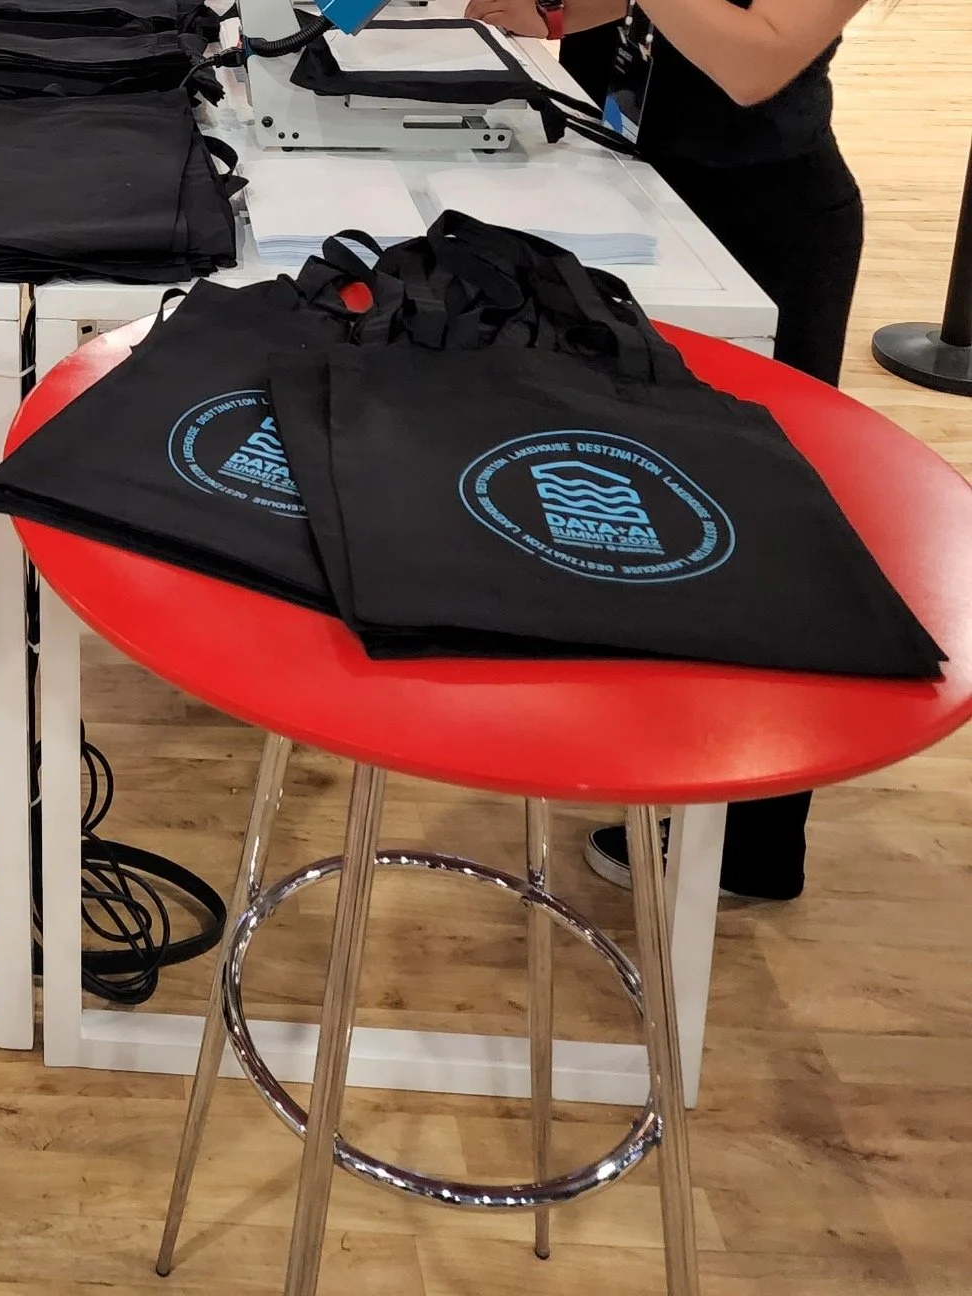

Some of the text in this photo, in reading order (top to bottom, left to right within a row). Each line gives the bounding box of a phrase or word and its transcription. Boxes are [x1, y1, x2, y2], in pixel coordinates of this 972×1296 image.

[196, 397, 257, 426] DESTINATION
[508, 442, 571, 460] LAKEHOUSE
[577, 442, 663, 476] DESTINATION
[223, 461, 280, 483] SUMMIT
[229, 452, 290, 478] DATA
[545, 512, 657, 539] DATA+AI
[549, 526, 660, 546] SUMMIT 2022
[522, 533, 614, 572] DESTINATION
